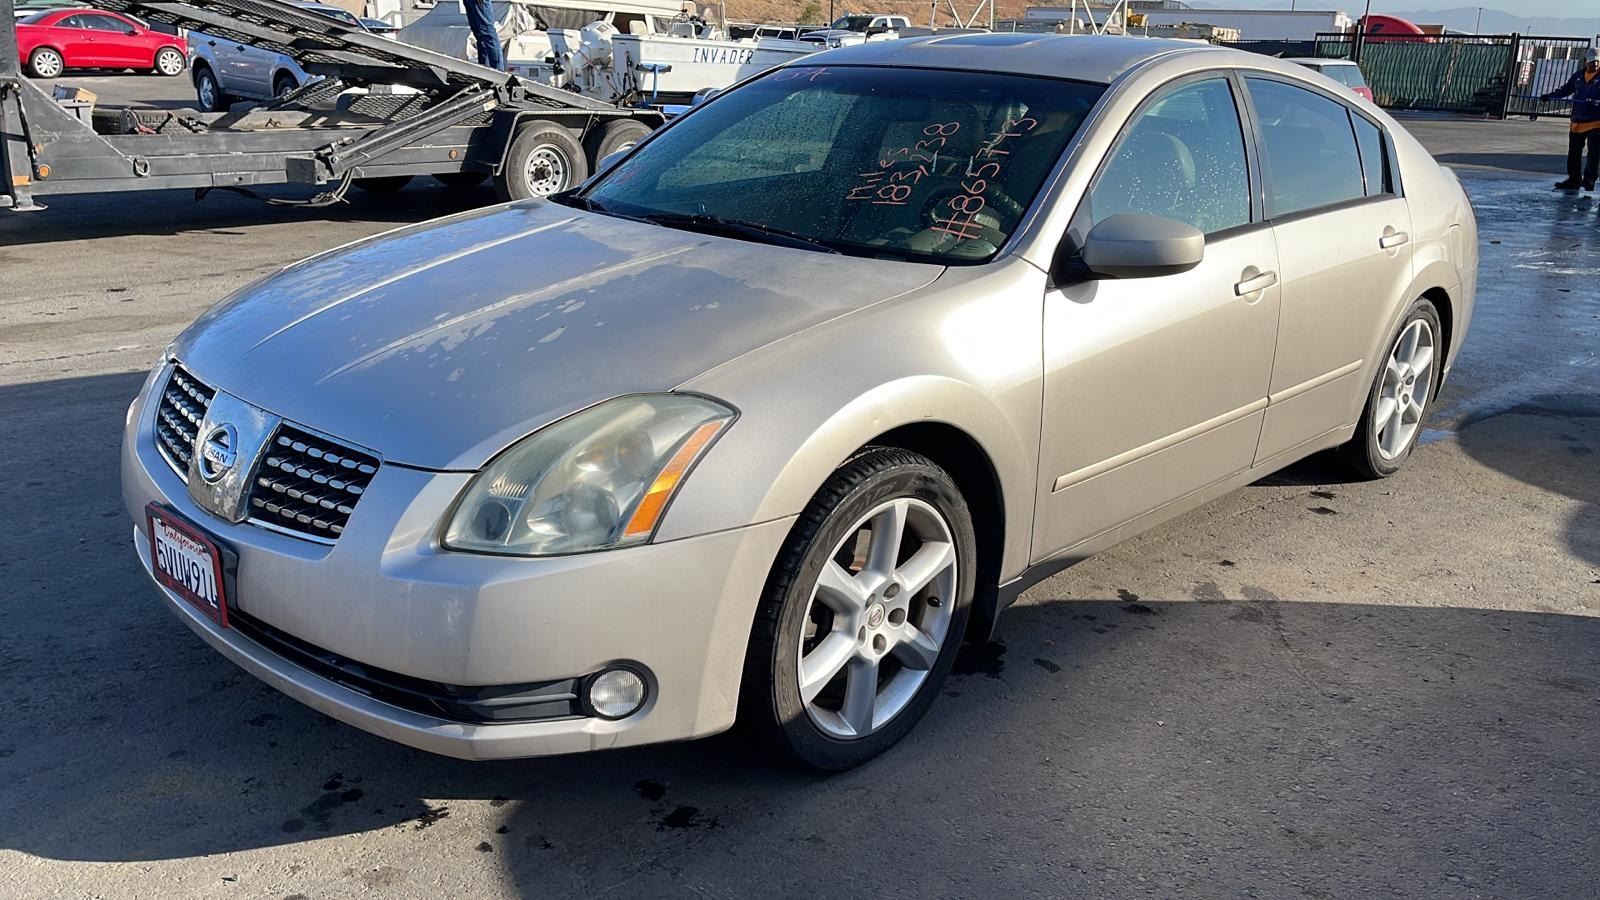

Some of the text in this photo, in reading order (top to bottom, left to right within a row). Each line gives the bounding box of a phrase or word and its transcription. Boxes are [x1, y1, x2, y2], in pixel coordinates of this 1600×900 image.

[693, 47, 754, 65] INVADER
[872, 122, 960, 204] 183,238
[930, 117, 1038, 241] #865743
